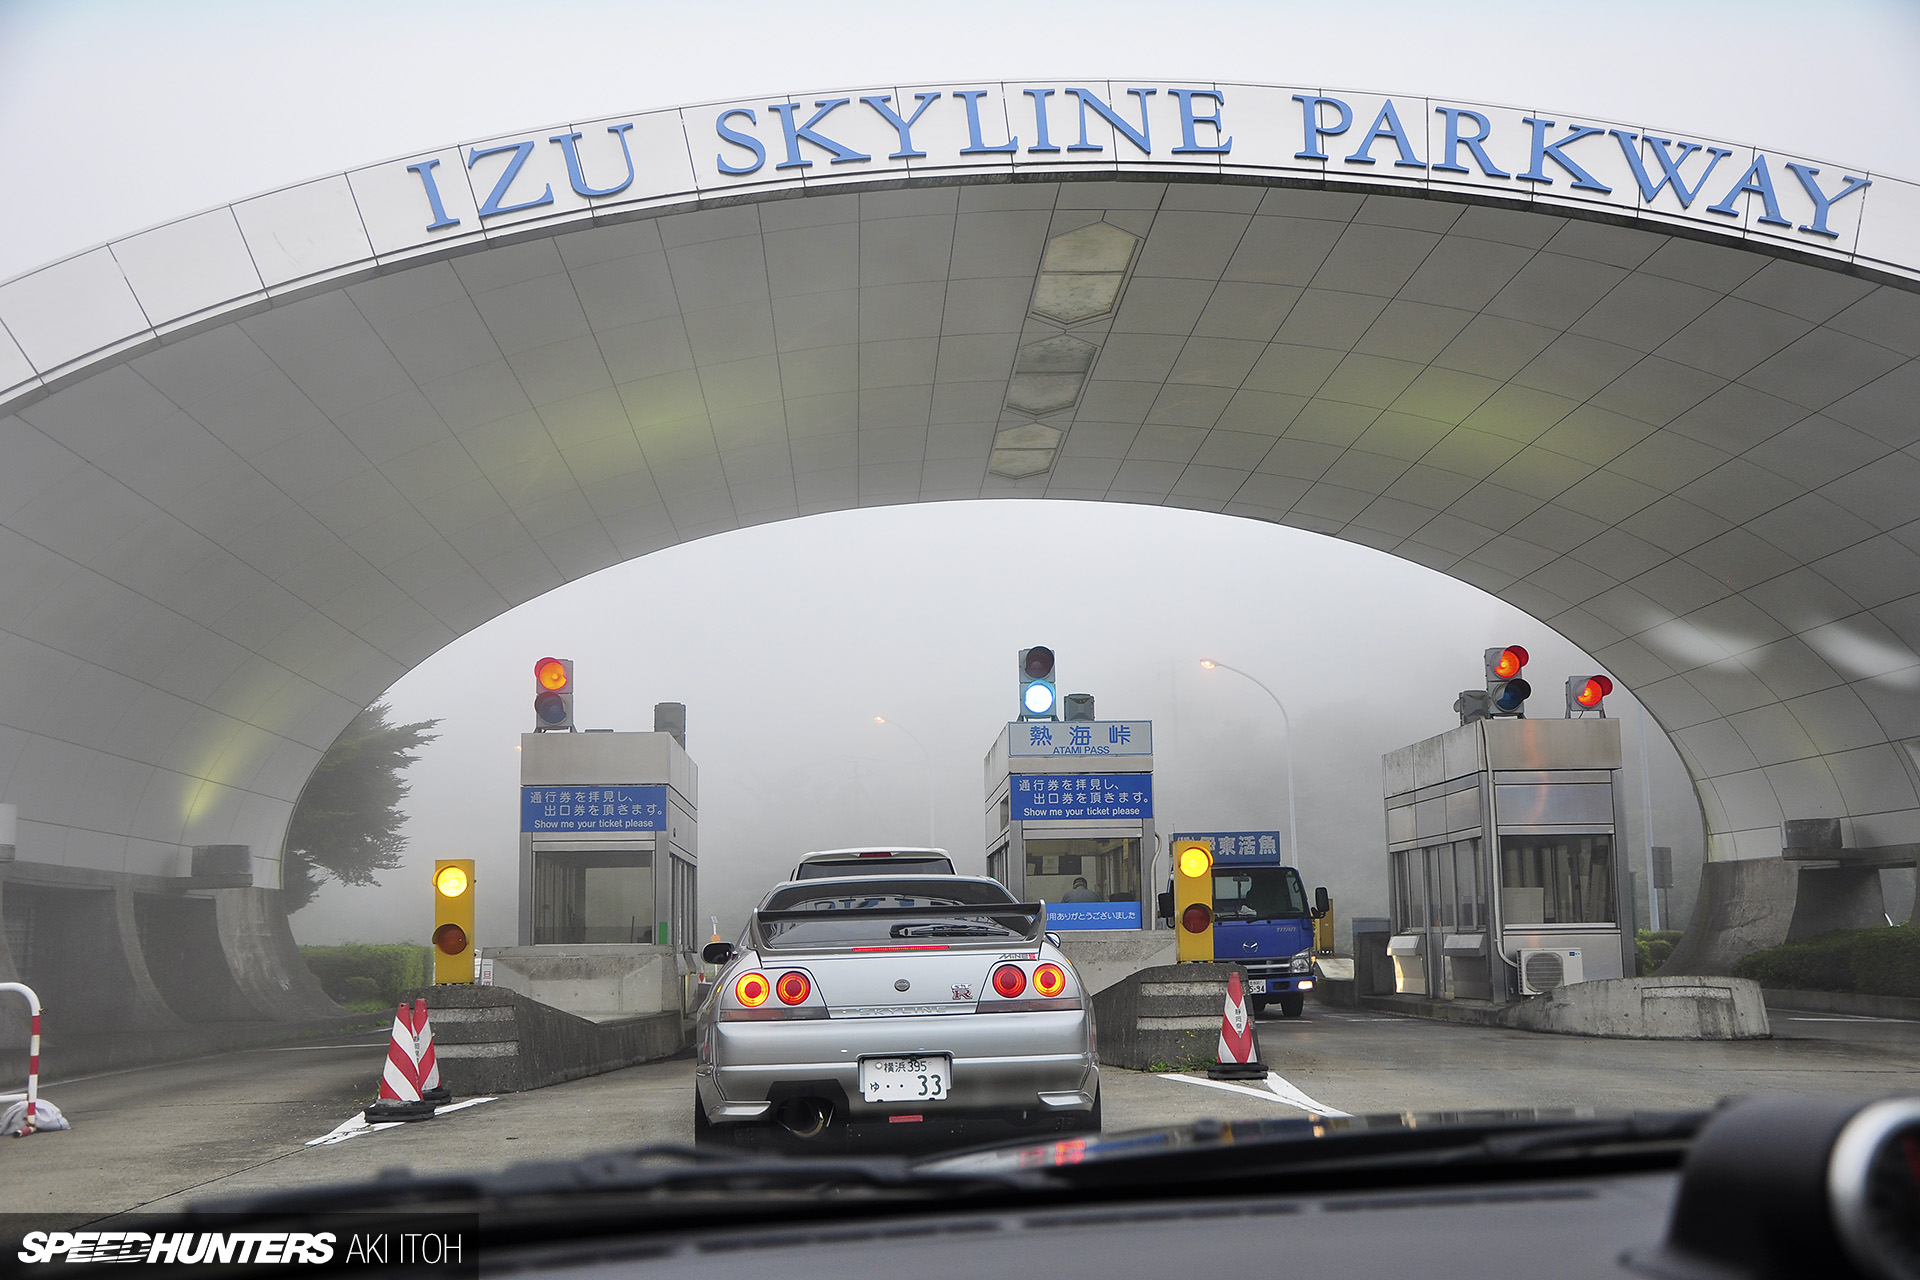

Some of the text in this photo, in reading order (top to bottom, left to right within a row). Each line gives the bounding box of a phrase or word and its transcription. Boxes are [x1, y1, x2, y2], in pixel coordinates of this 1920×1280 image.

[407, 88, 1872, 239] IZU SKYLINE PARKWAY
[1030, 725, 1131, 746] 熱海峠
[1053, 746, 1110, 755] ATAMI PASS
[1023, 808, 1047, 816] Show
[1065, 809, 1083, 817] your
[1087, 807, 1109, 816] ticket
[1113, 807, 1140, 817] please
[534, 820, 558, 828] Show
[577, 821, 595, 829] your
[599, 819, 622, 828] ticket
[625, 819, 653, 828] please
[860, 1006, 946, 1015] SKYLINE
